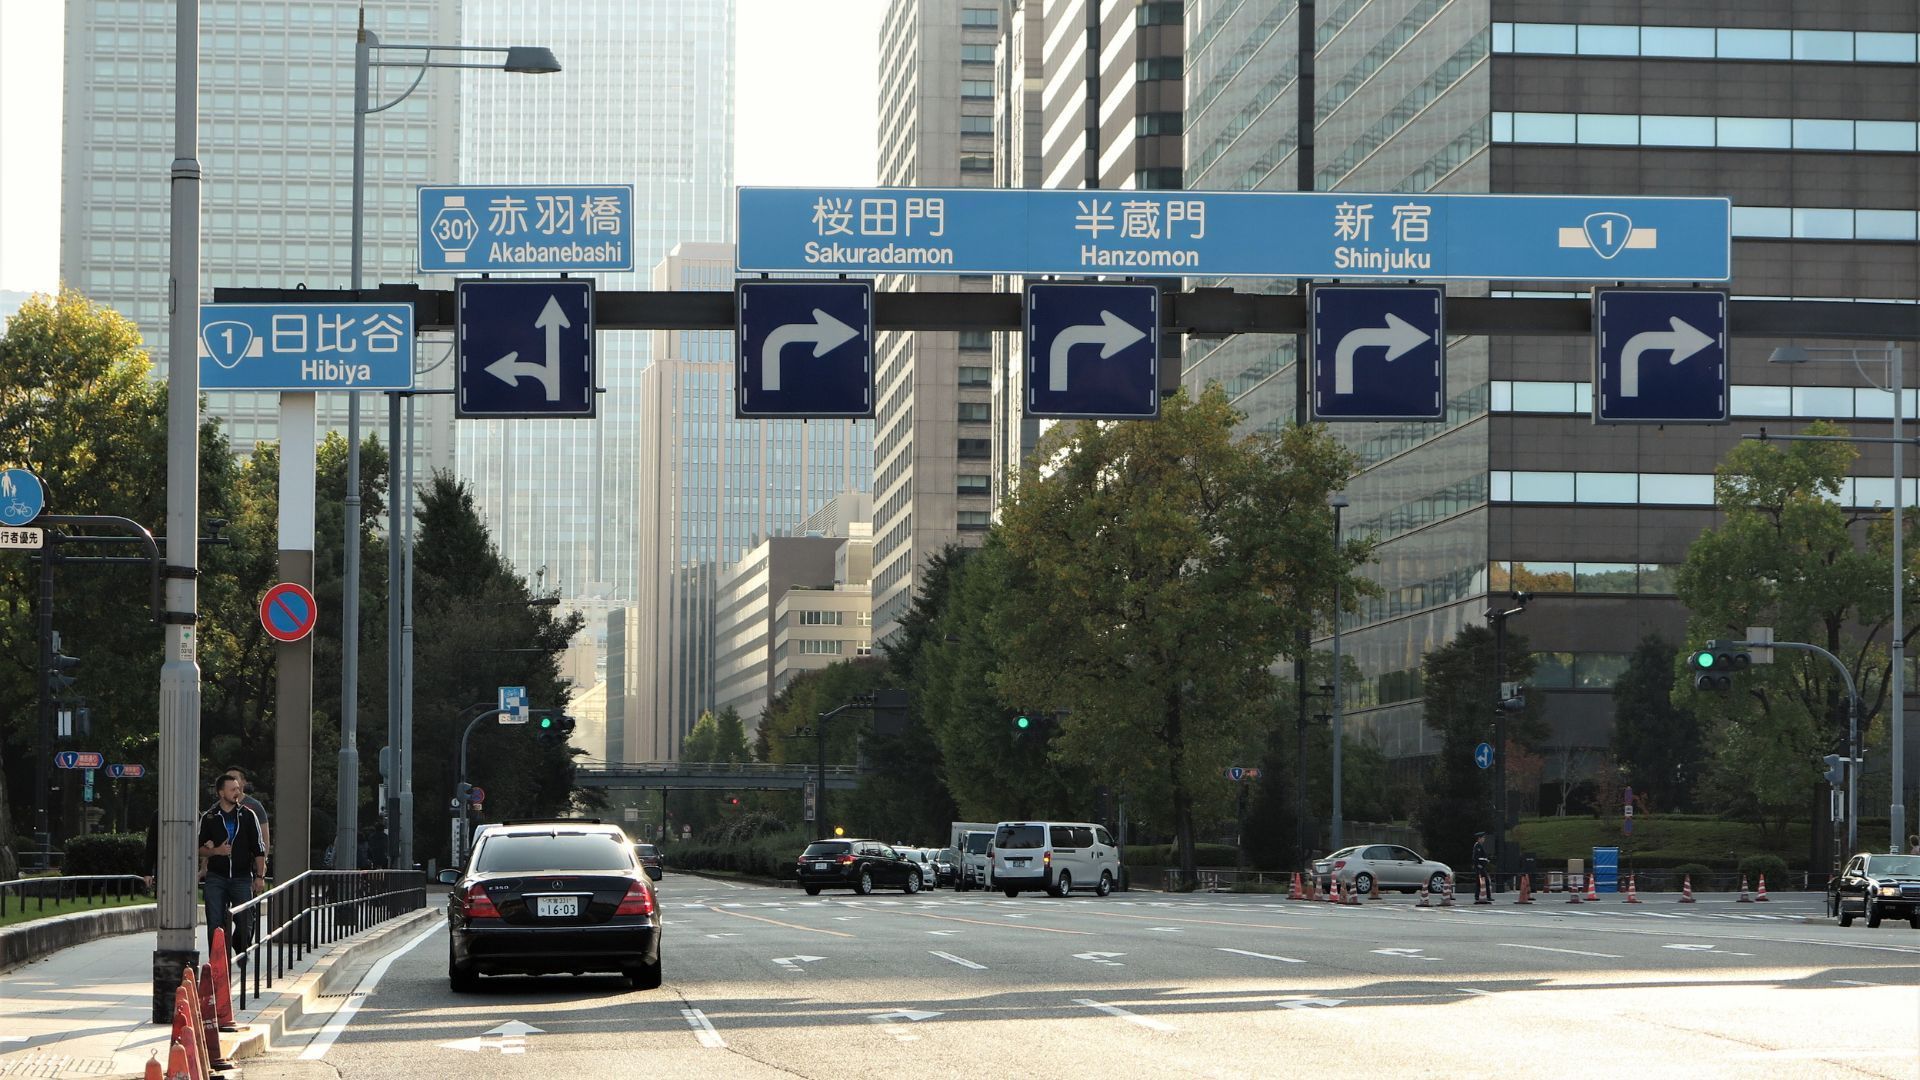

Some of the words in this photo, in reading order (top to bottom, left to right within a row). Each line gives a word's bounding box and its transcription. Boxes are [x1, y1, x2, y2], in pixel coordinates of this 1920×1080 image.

[488, 195, 622, 236] 赤羽橋
[811, 196, 945, 237] 桜田門
[1074, 198, 1205, 240] 半蔵門
[1333, 201, 1432, 242] 新宿
[438, 218, 474, 242] 301
[1601, 219, 1613, 246] 1
[488, 241, 622, 263] Akabanebashi
[804, 241, 954, 265] Sakuradamon
[1081, 244, 1199, 267] Hanzomon
[1333, 246, 1432, 272] Shinjuku
[221, 328, 233, 355] 1
[272, 313, 404, 353] 日比谷
[301, 358, 371, 384] Hibiya
[547, 904, 576, 915] 16-03
